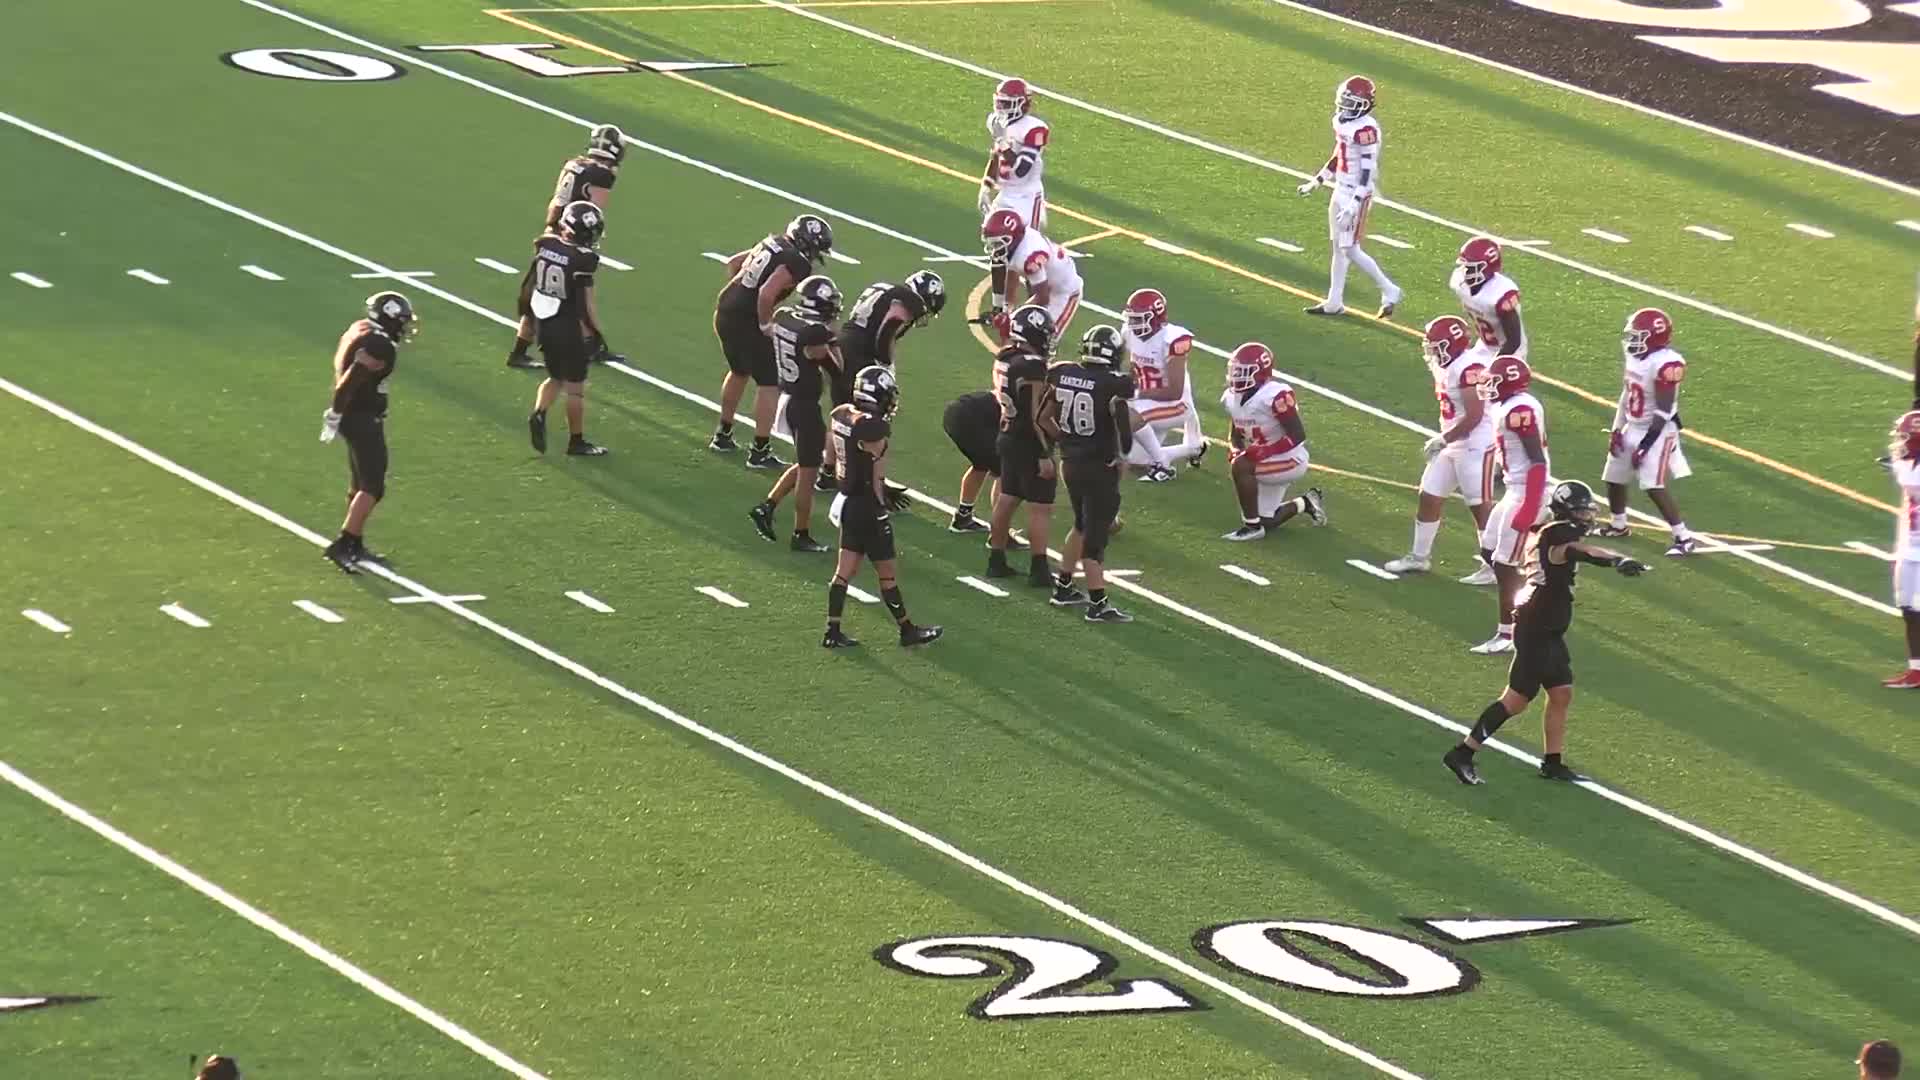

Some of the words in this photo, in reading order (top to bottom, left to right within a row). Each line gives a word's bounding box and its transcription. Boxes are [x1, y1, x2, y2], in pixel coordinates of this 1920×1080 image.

[1003, 214, 1017, 231] S
[1484, 246, 1500, 263] S
[1153, 299, 1165, 316] S
[1449, 323, 1464, 340] S
[1653, 317, 1666, 334] S
[1259, 352, 1272, 369] S
[1505, 365, 1521, 381] S
[1055, 387, 1097, 437] 78
[873, 919, 1482, 1019] 20
